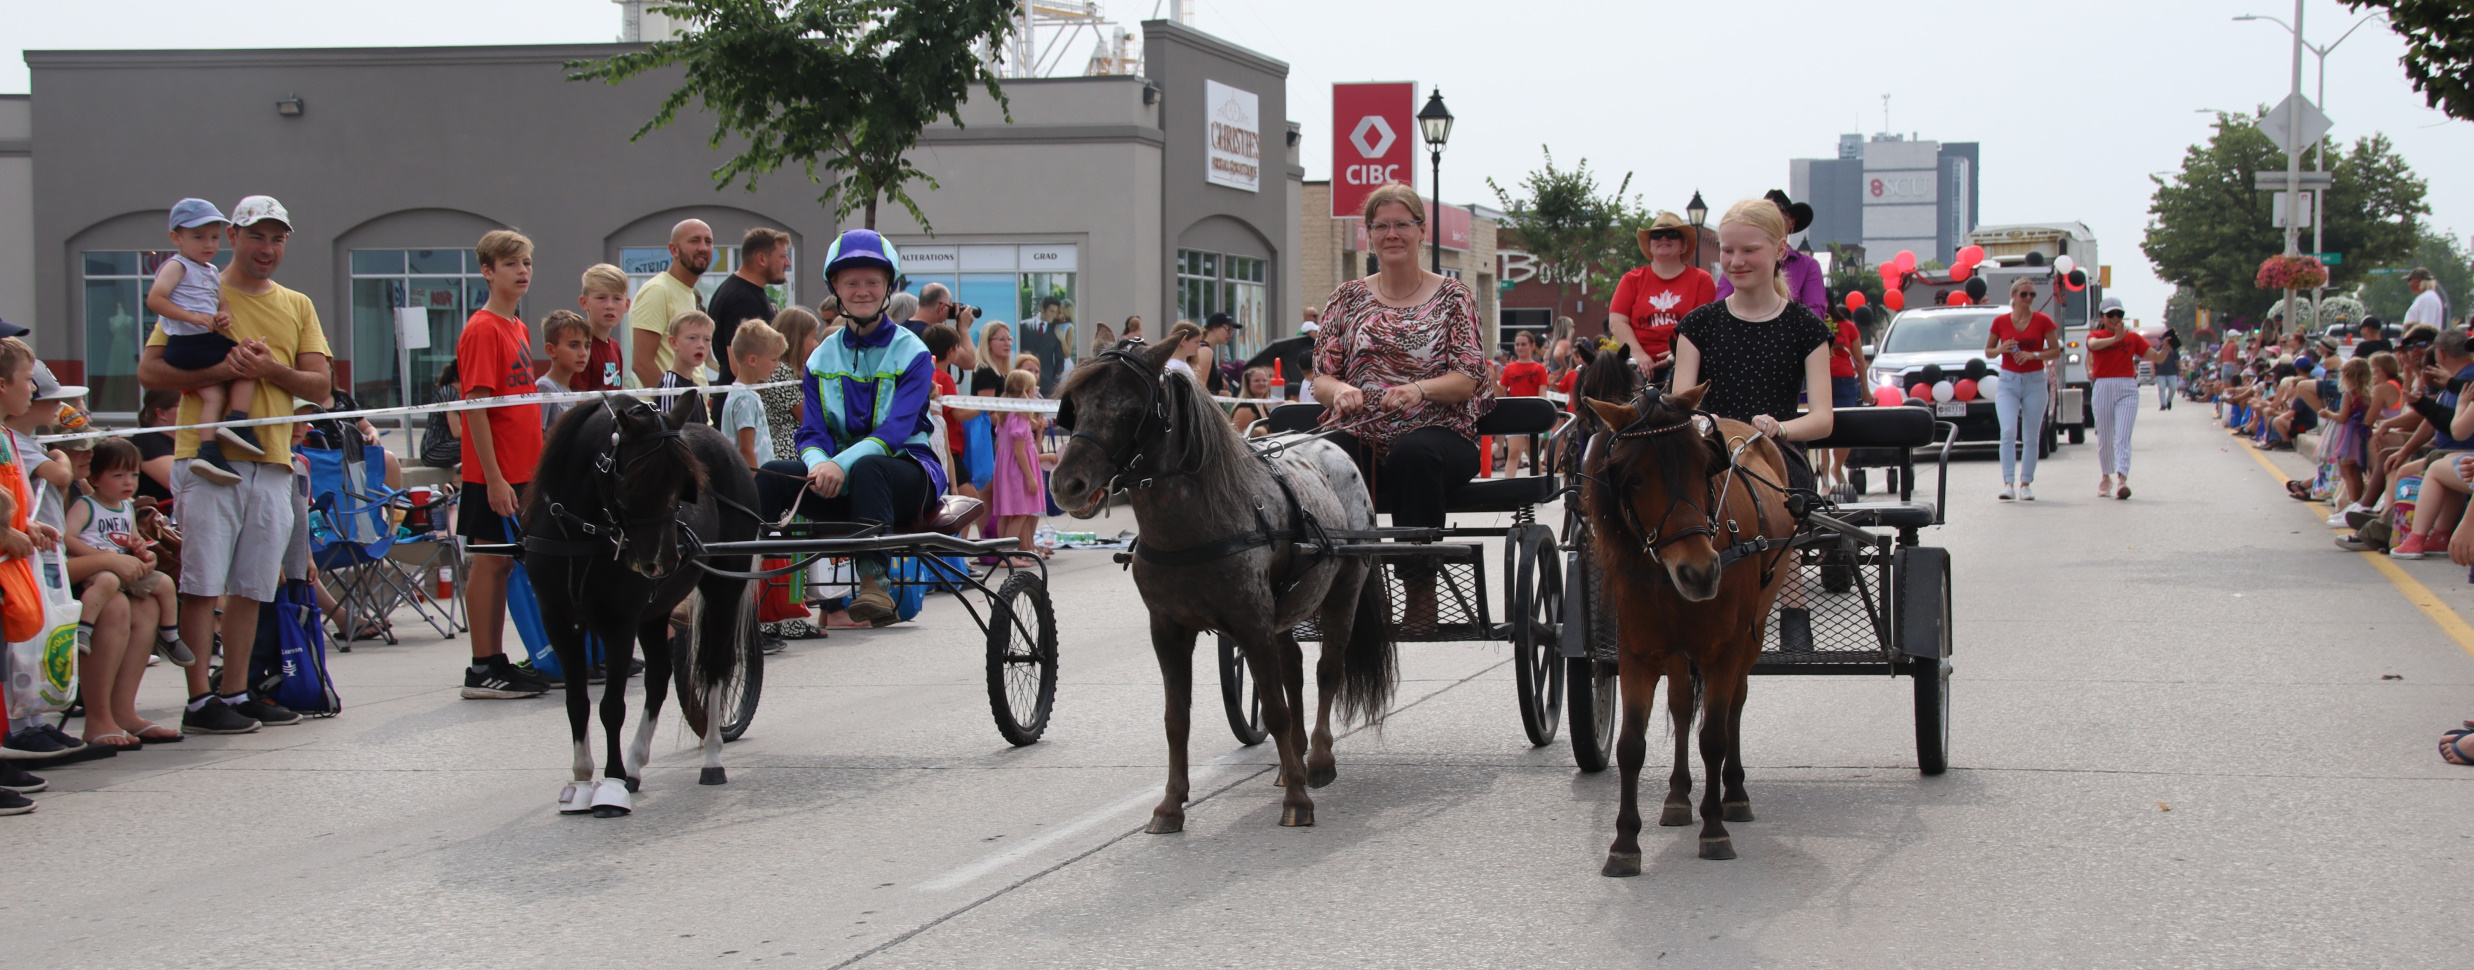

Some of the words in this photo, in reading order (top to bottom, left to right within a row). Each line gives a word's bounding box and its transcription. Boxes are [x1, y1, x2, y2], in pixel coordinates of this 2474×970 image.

[1346, 164, 1399, 185] CIBC
[1884, 177, 1928, 196] SCU
[901, 253, 954, 261] ALTERATIONS
[98, 517, 119, 533] ONE
[121, 517, 130, 533] IN
